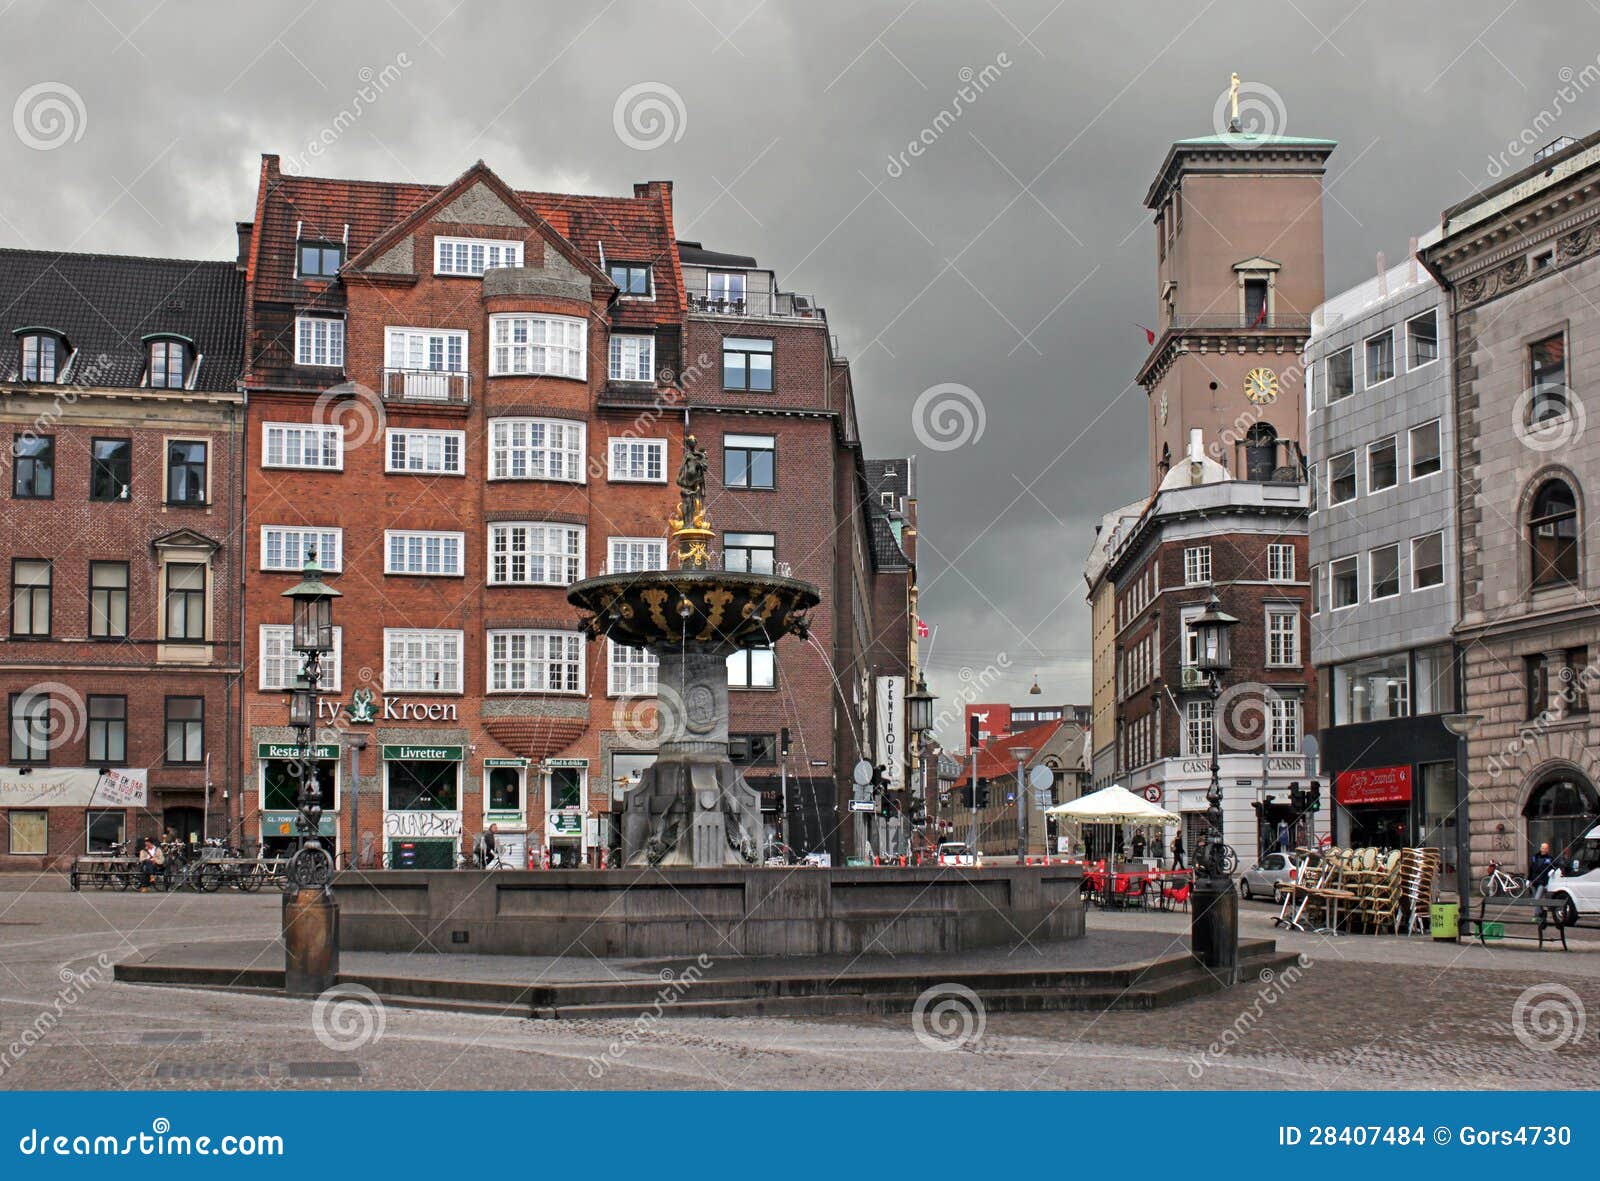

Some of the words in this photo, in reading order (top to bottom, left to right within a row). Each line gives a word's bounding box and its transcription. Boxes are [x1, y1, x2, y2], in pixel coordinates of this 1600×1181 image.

[317, 697, 342, 725] ty
[383, 697, 458, 721] Kroen
[886, 679, 895, 776] PENTHOUSE
[269, 745, 329, 757] Restarnt
[401, 747, 447, 758] Livretter
[1183, 761, 1211, 773] CASSI
[1268, 759, 1301, 771] CASSIS
